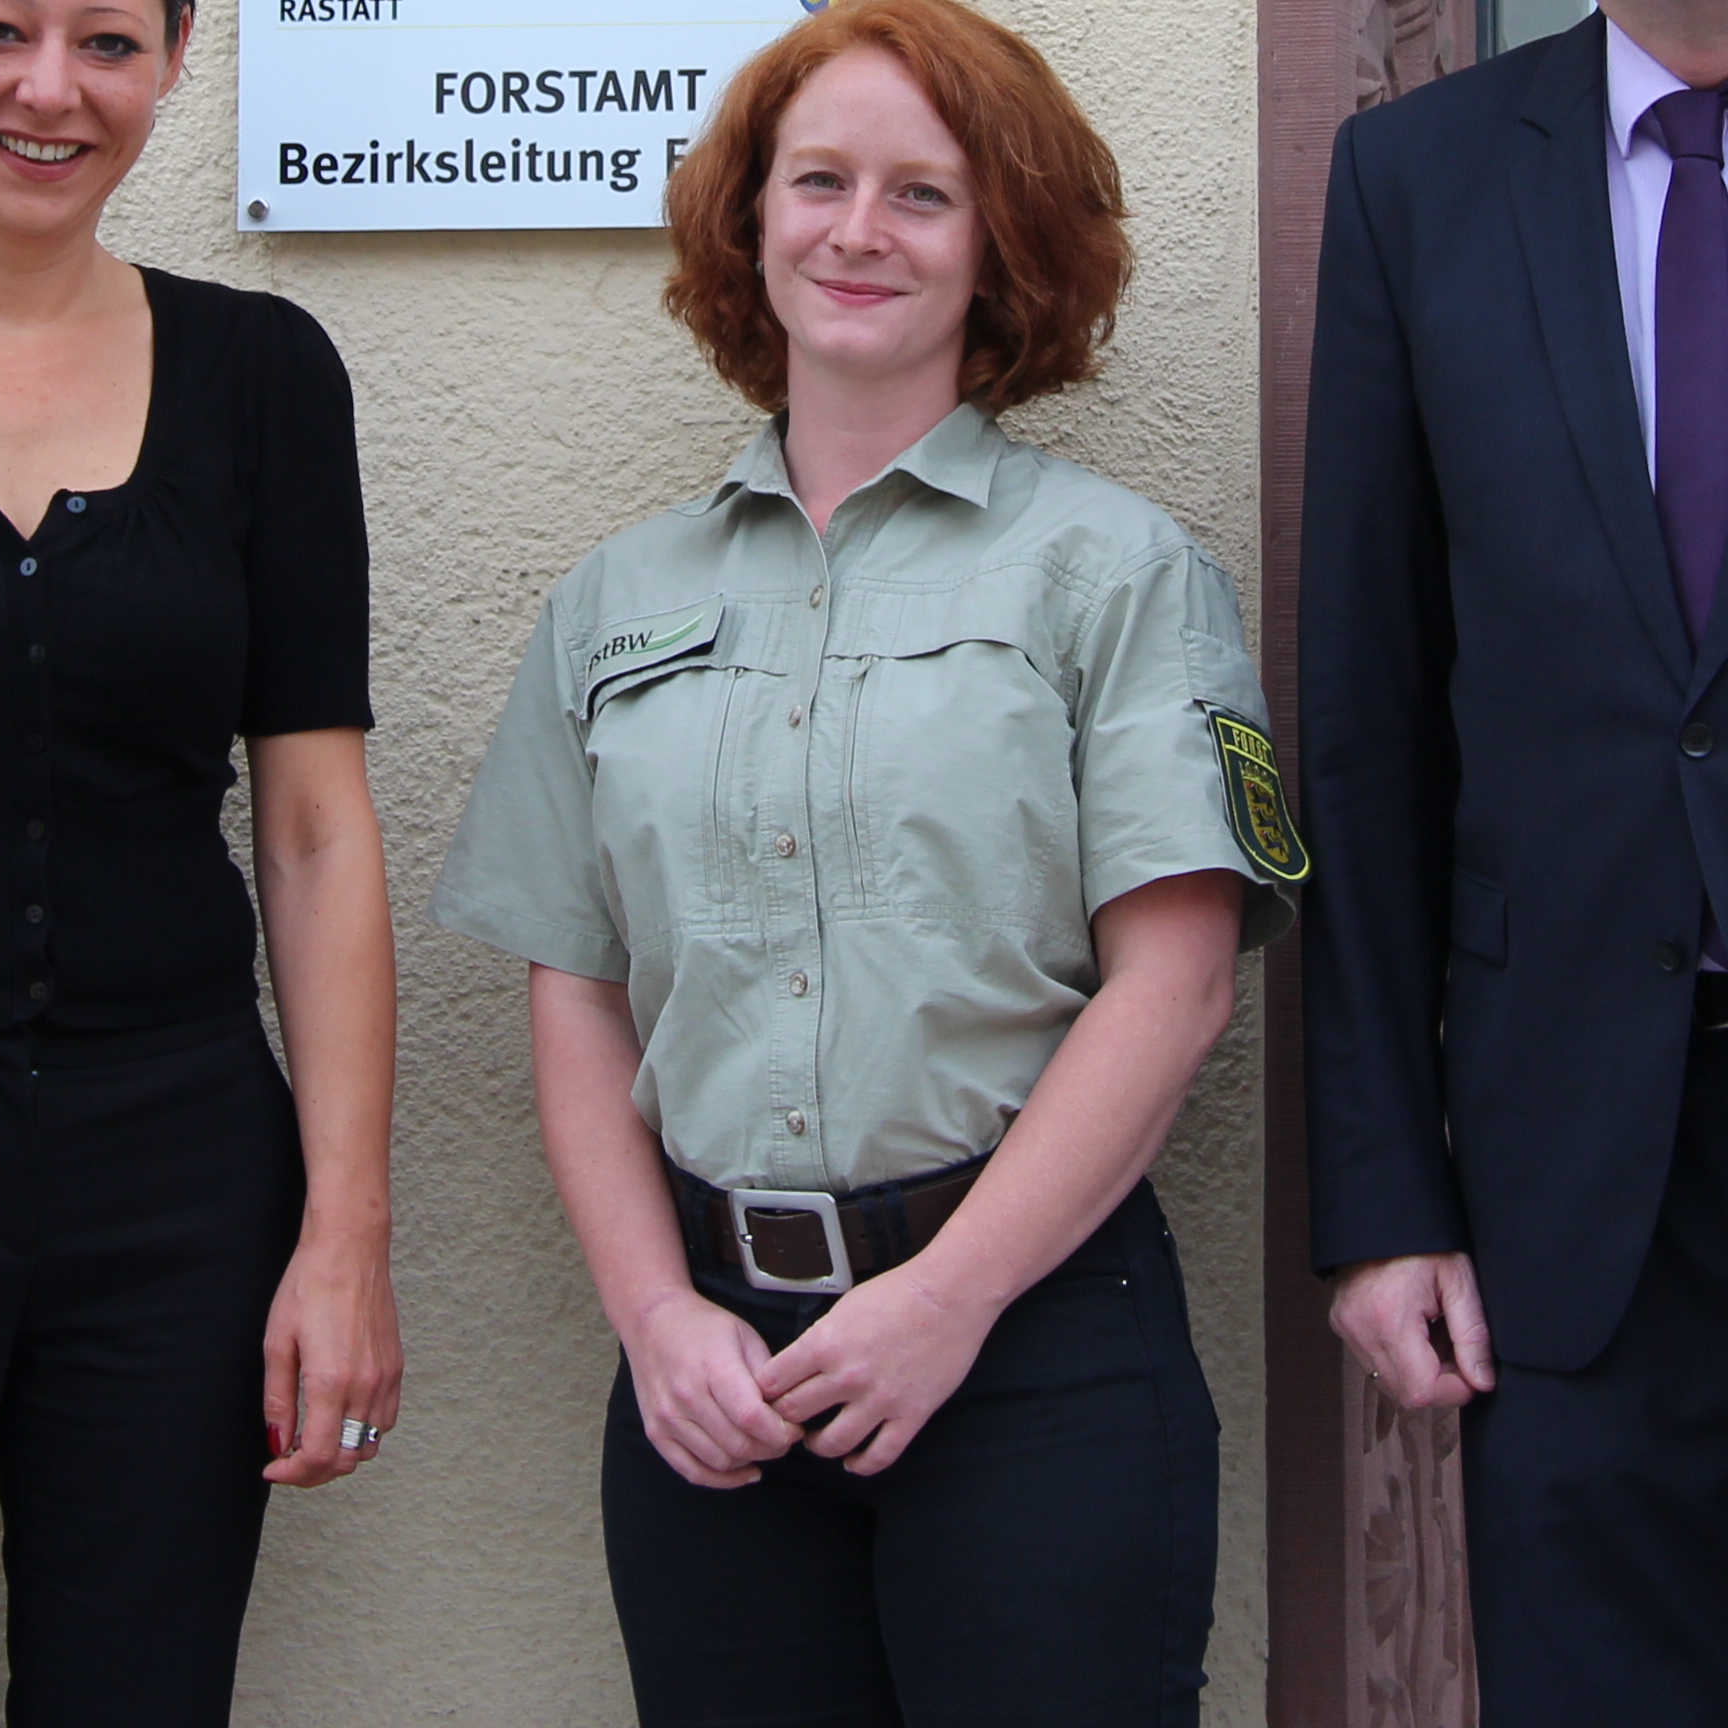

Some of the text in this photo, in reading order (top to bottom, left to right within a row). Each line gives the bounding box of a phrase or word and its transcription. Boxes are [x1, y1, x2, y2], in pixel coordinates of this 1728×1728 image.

[435, 69, 708, 115] FORSTAMT
[278, 138, 642, 193] Bezirksleitung
[1231, 727, 1271, 763] FORST
